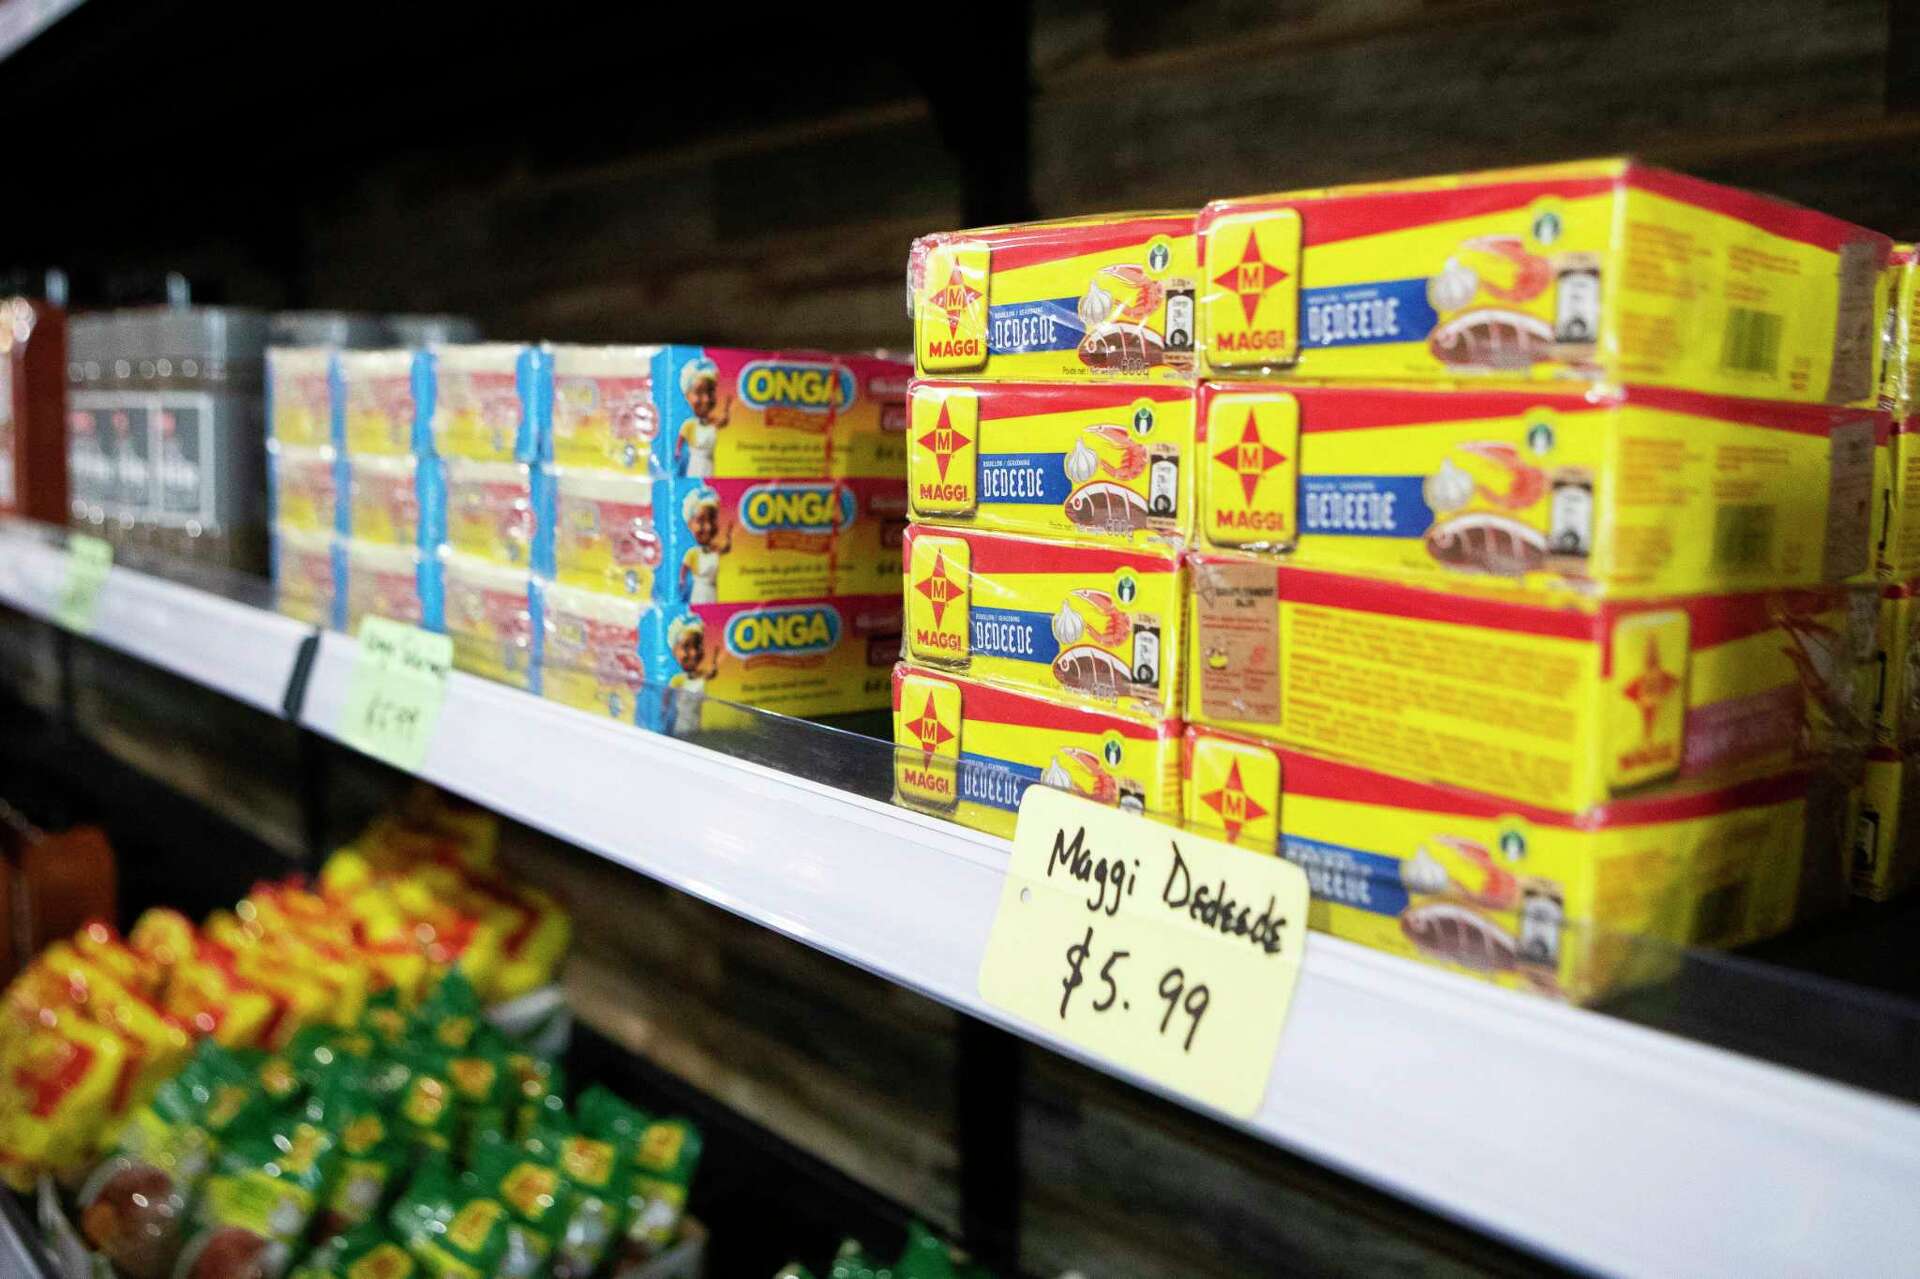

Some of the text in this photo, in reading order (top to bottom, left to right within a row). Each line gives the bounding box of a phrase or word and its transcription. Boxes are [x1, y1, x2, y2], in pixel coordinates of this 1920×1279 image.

[1241, 266, 1260, 290] M
[948, 288, 961, 308] M
[929, 339, 979, 358] MAGGI
[1216, 330, 1285, 352] MAGGI
[747, 368, 845, 404] ONGA
[937, 431, 950, 451] M
[1241, 446, 1259, 469] M
[919, 483, 968, 502] MAGGI
[983, 468, 1044, 497] DEDEEDE
[1216, 508, 1285, 532] MAGGI
[932, 579, 946, 601] M
[734, 611, 832, 651] ONGA
[916, 628, 962, 651] MAGGI
[922, 720, 936, 741] M
[903, 767, 950, 794] MAGGI
[1226, 793, 1243, 816] M
[1047, 826, 1141, 916] Maggi
[1060, 926, 1210, 1052] $5.99
